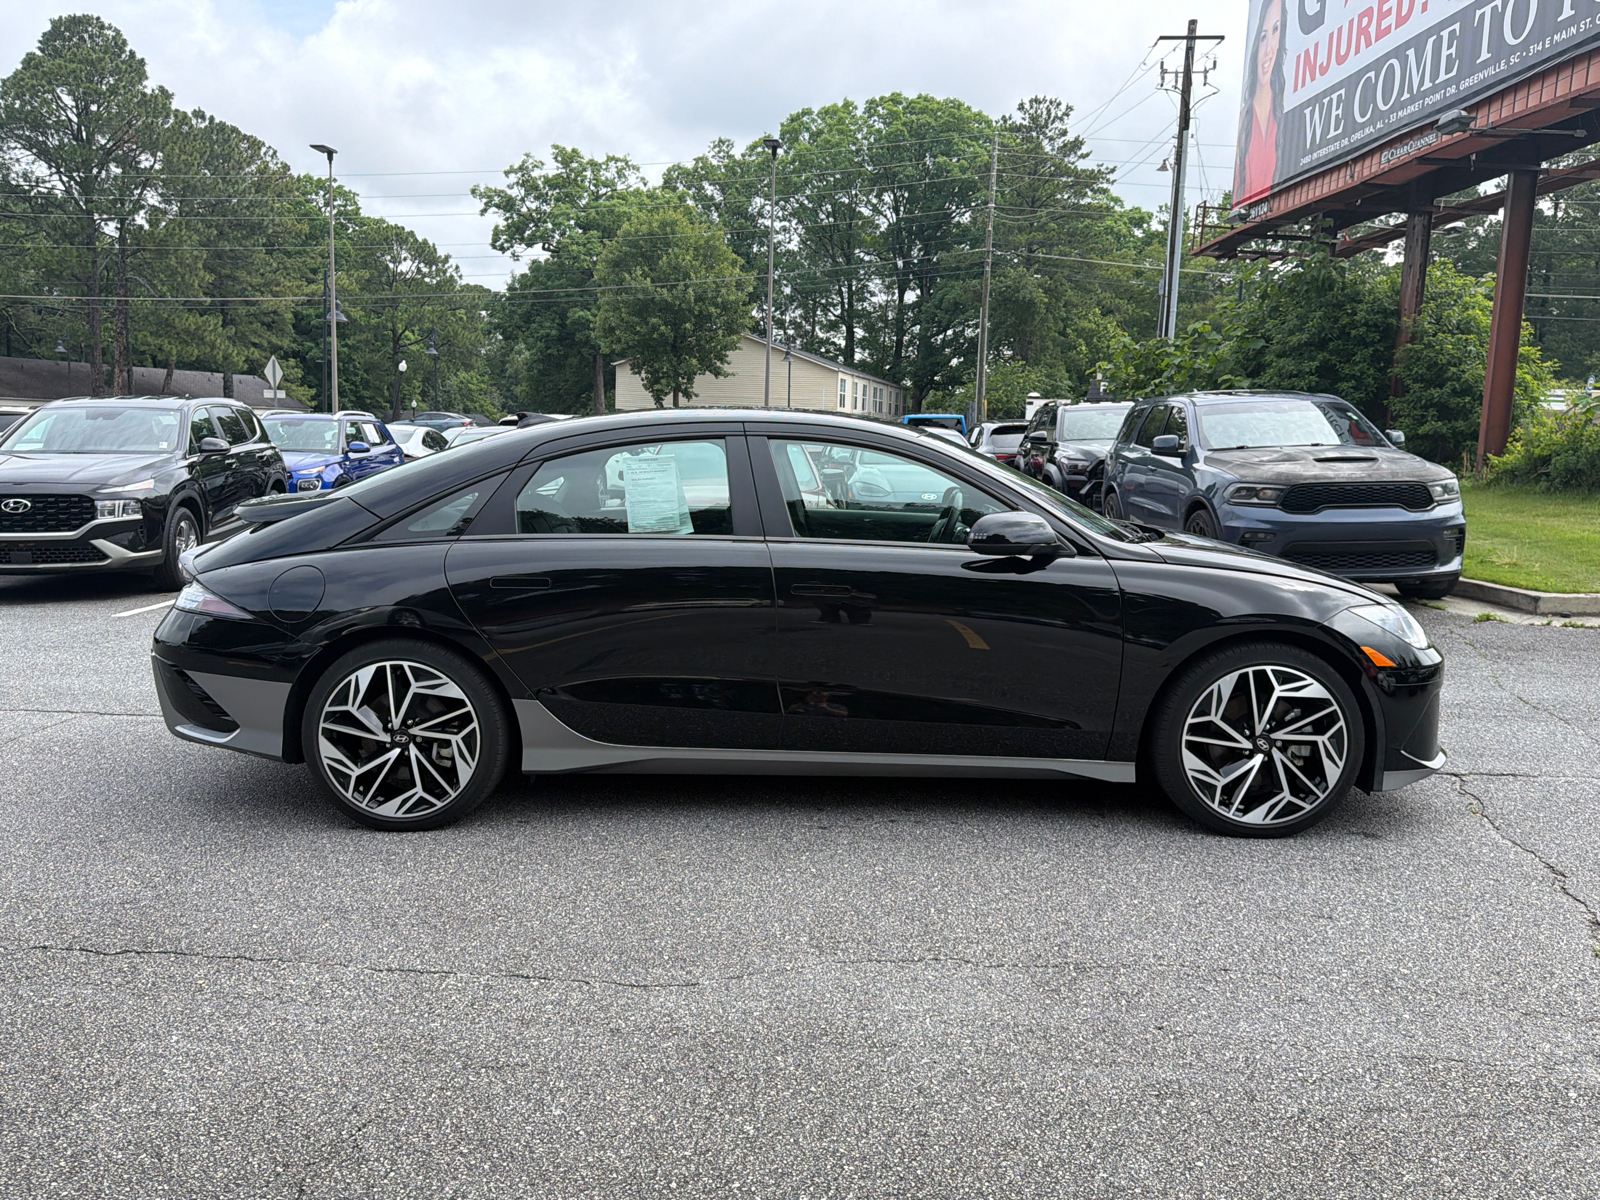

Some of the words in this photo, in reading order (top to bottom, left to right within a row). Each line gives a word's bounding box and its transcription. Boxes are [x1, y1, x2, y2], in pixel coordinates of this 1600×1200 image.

[1304, 88, 1345, 149] WE
[1353, 22, 1460, 123] COME
[1474, 0, 1538, 65] TO
[1312, 141, 1340, 160] INTERSTATE
[1341, 137, 1350, 148] DR.
[1351, 125, 1375, 143] OPELIKA,
[1376, 121, 1384, 130] AL
[1389, 112, 1397, 123] 33
[1398, 99, 1423, 119] MARKET
[1424, 90, 1445, 107] POINT
[1446, 85, 1458, 97] DR.
[1460, 59, 1507, 90] GREENVILLE,
[1509, 52, 1521, 66] SC
[1528, 41, 1543, 56] 314
[1545, 36, 1551, 48] E
[1553, 24, 1577, 44] MAIN
[1579, 17, 1593, 32] ST.
